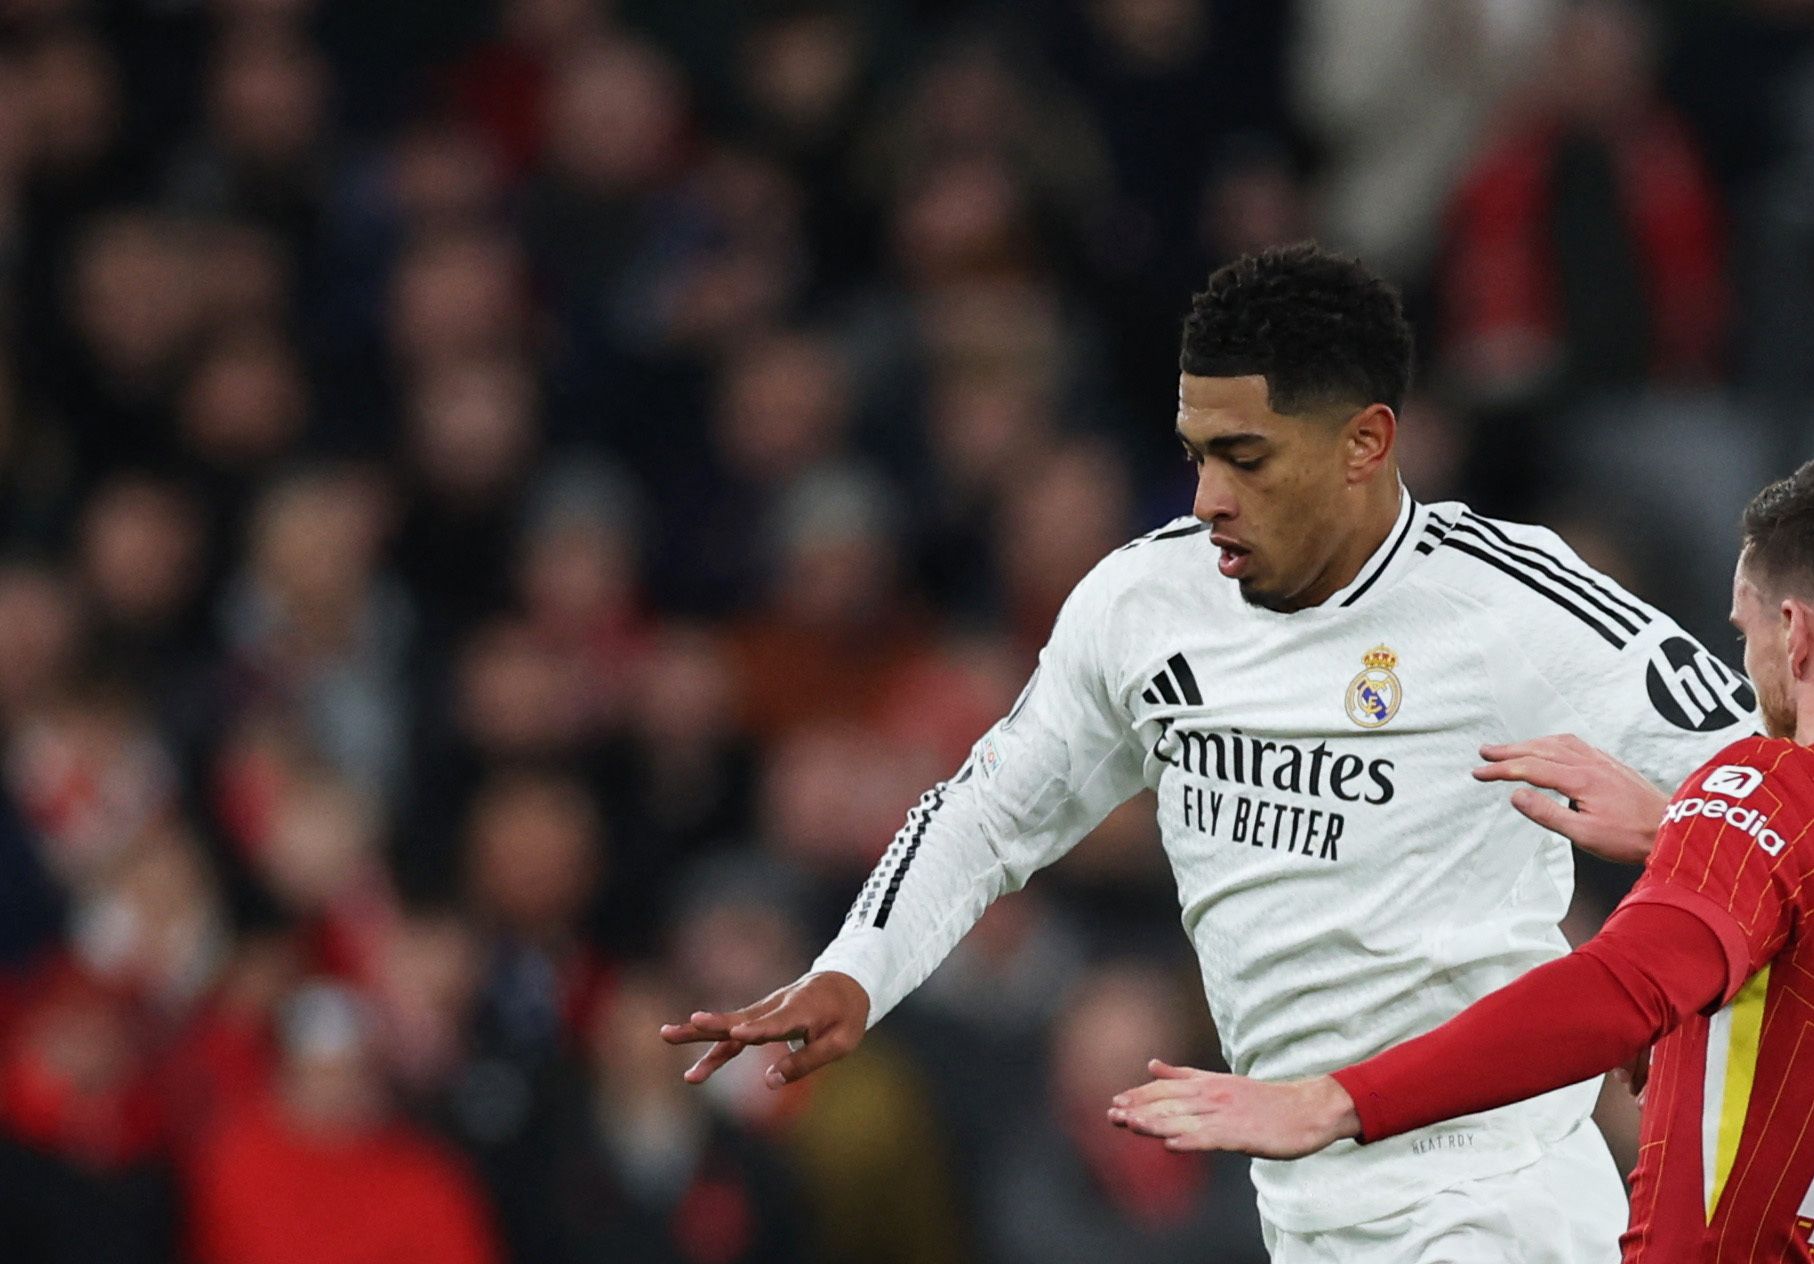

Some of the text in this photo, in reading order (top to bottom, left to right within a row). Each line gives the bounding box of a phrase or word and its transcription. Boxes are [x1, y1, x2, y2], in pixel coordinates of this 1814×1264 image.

[1646, 637, 1757, 732] hp
[1153, 717, 1396, 806] Emirates
[1183, 784, 1346, 862] FLY BETTER
[1660, 796, 1787, 857] xpedia
[1411, 1133, 1474, 1155] HEAT RDY
